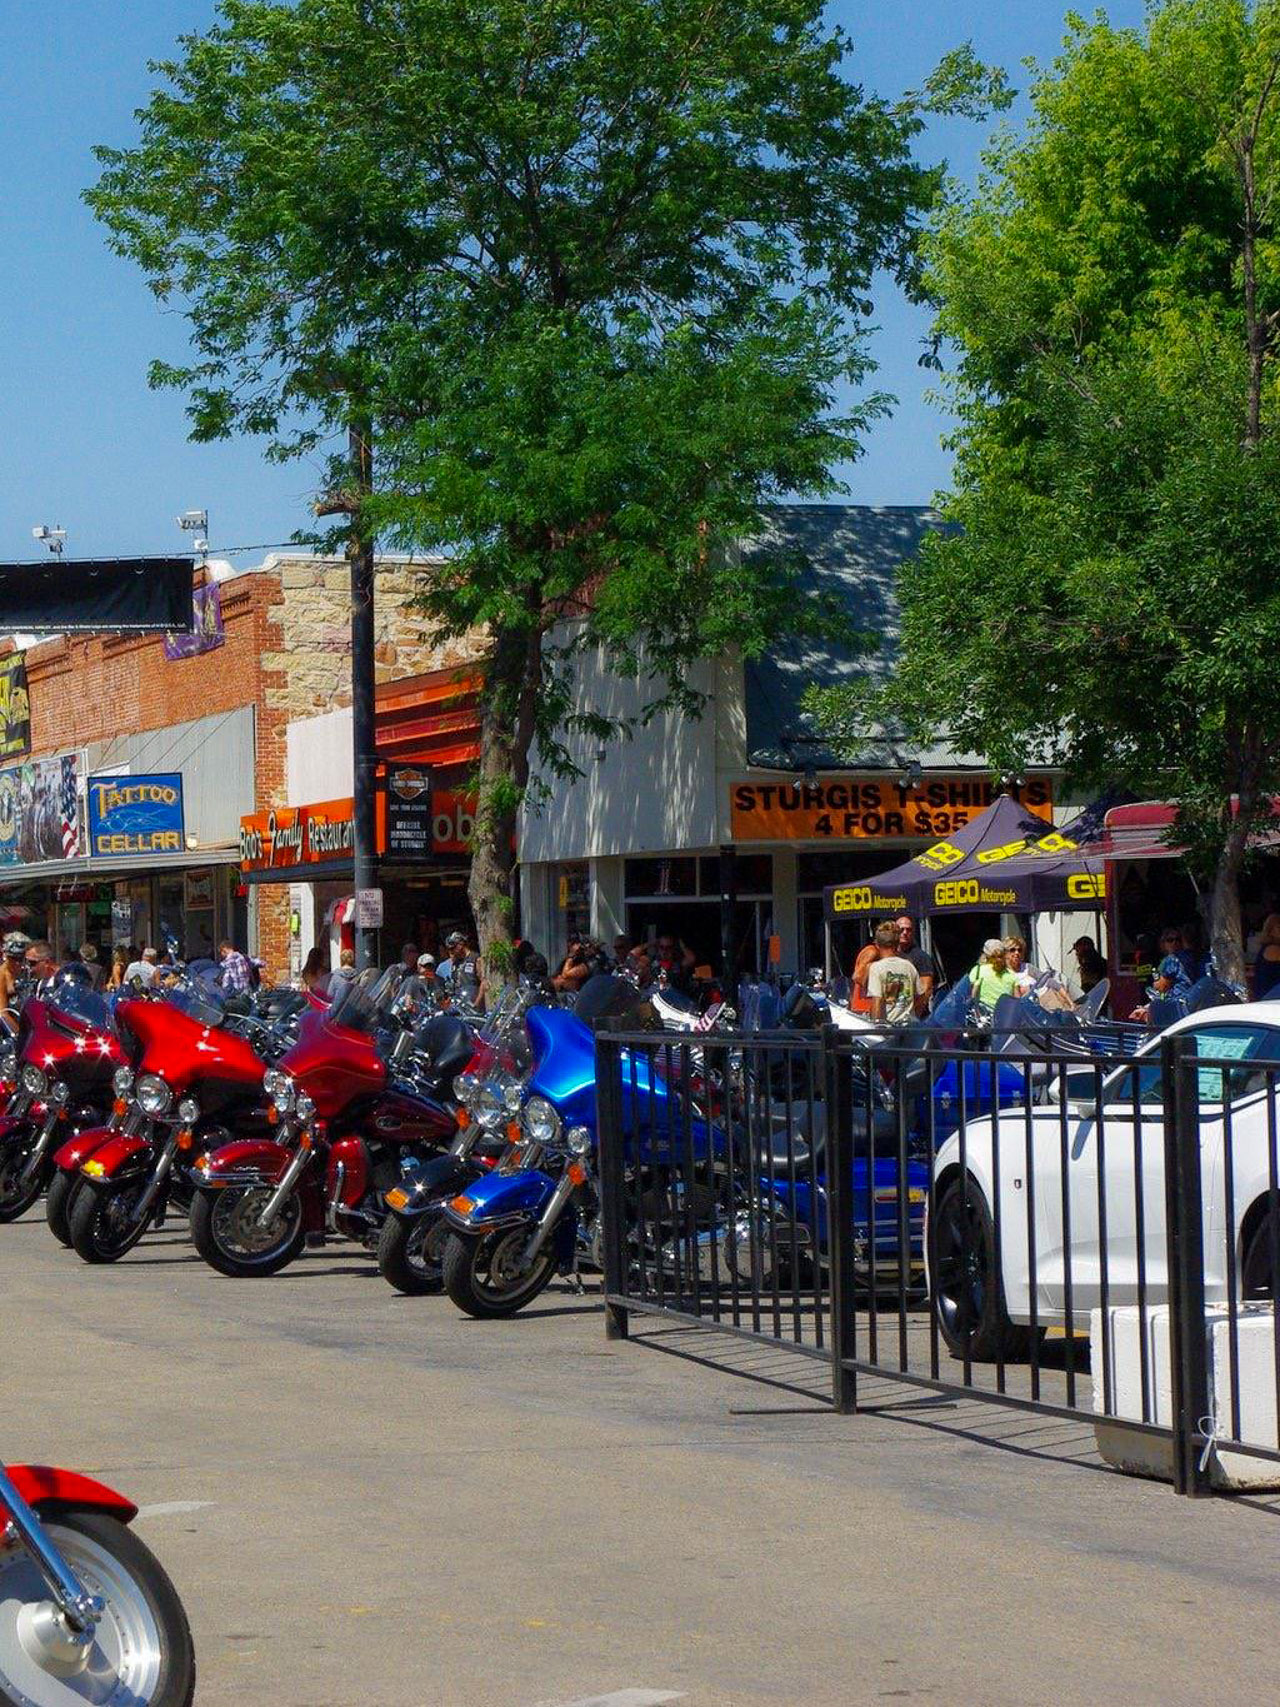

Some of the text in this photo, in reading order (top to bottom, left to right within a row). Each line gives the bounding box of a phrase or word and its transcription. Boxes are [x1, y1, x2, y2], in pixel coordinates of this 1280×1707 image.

[734, 784, 881, 812] STURGIS
[433, 804, 476, 842] ob
[815, 809, 969, 835] 4 FOR $35
[96, 831, 180, 853] CELLAR
[268, 807, 303, 868] Family
[308, 816, 356, 853] Restauran
[833, 887, 907, 912] GEICO Motorcycle
[934, 879, 1016, 906] GEICO Motorcycle
